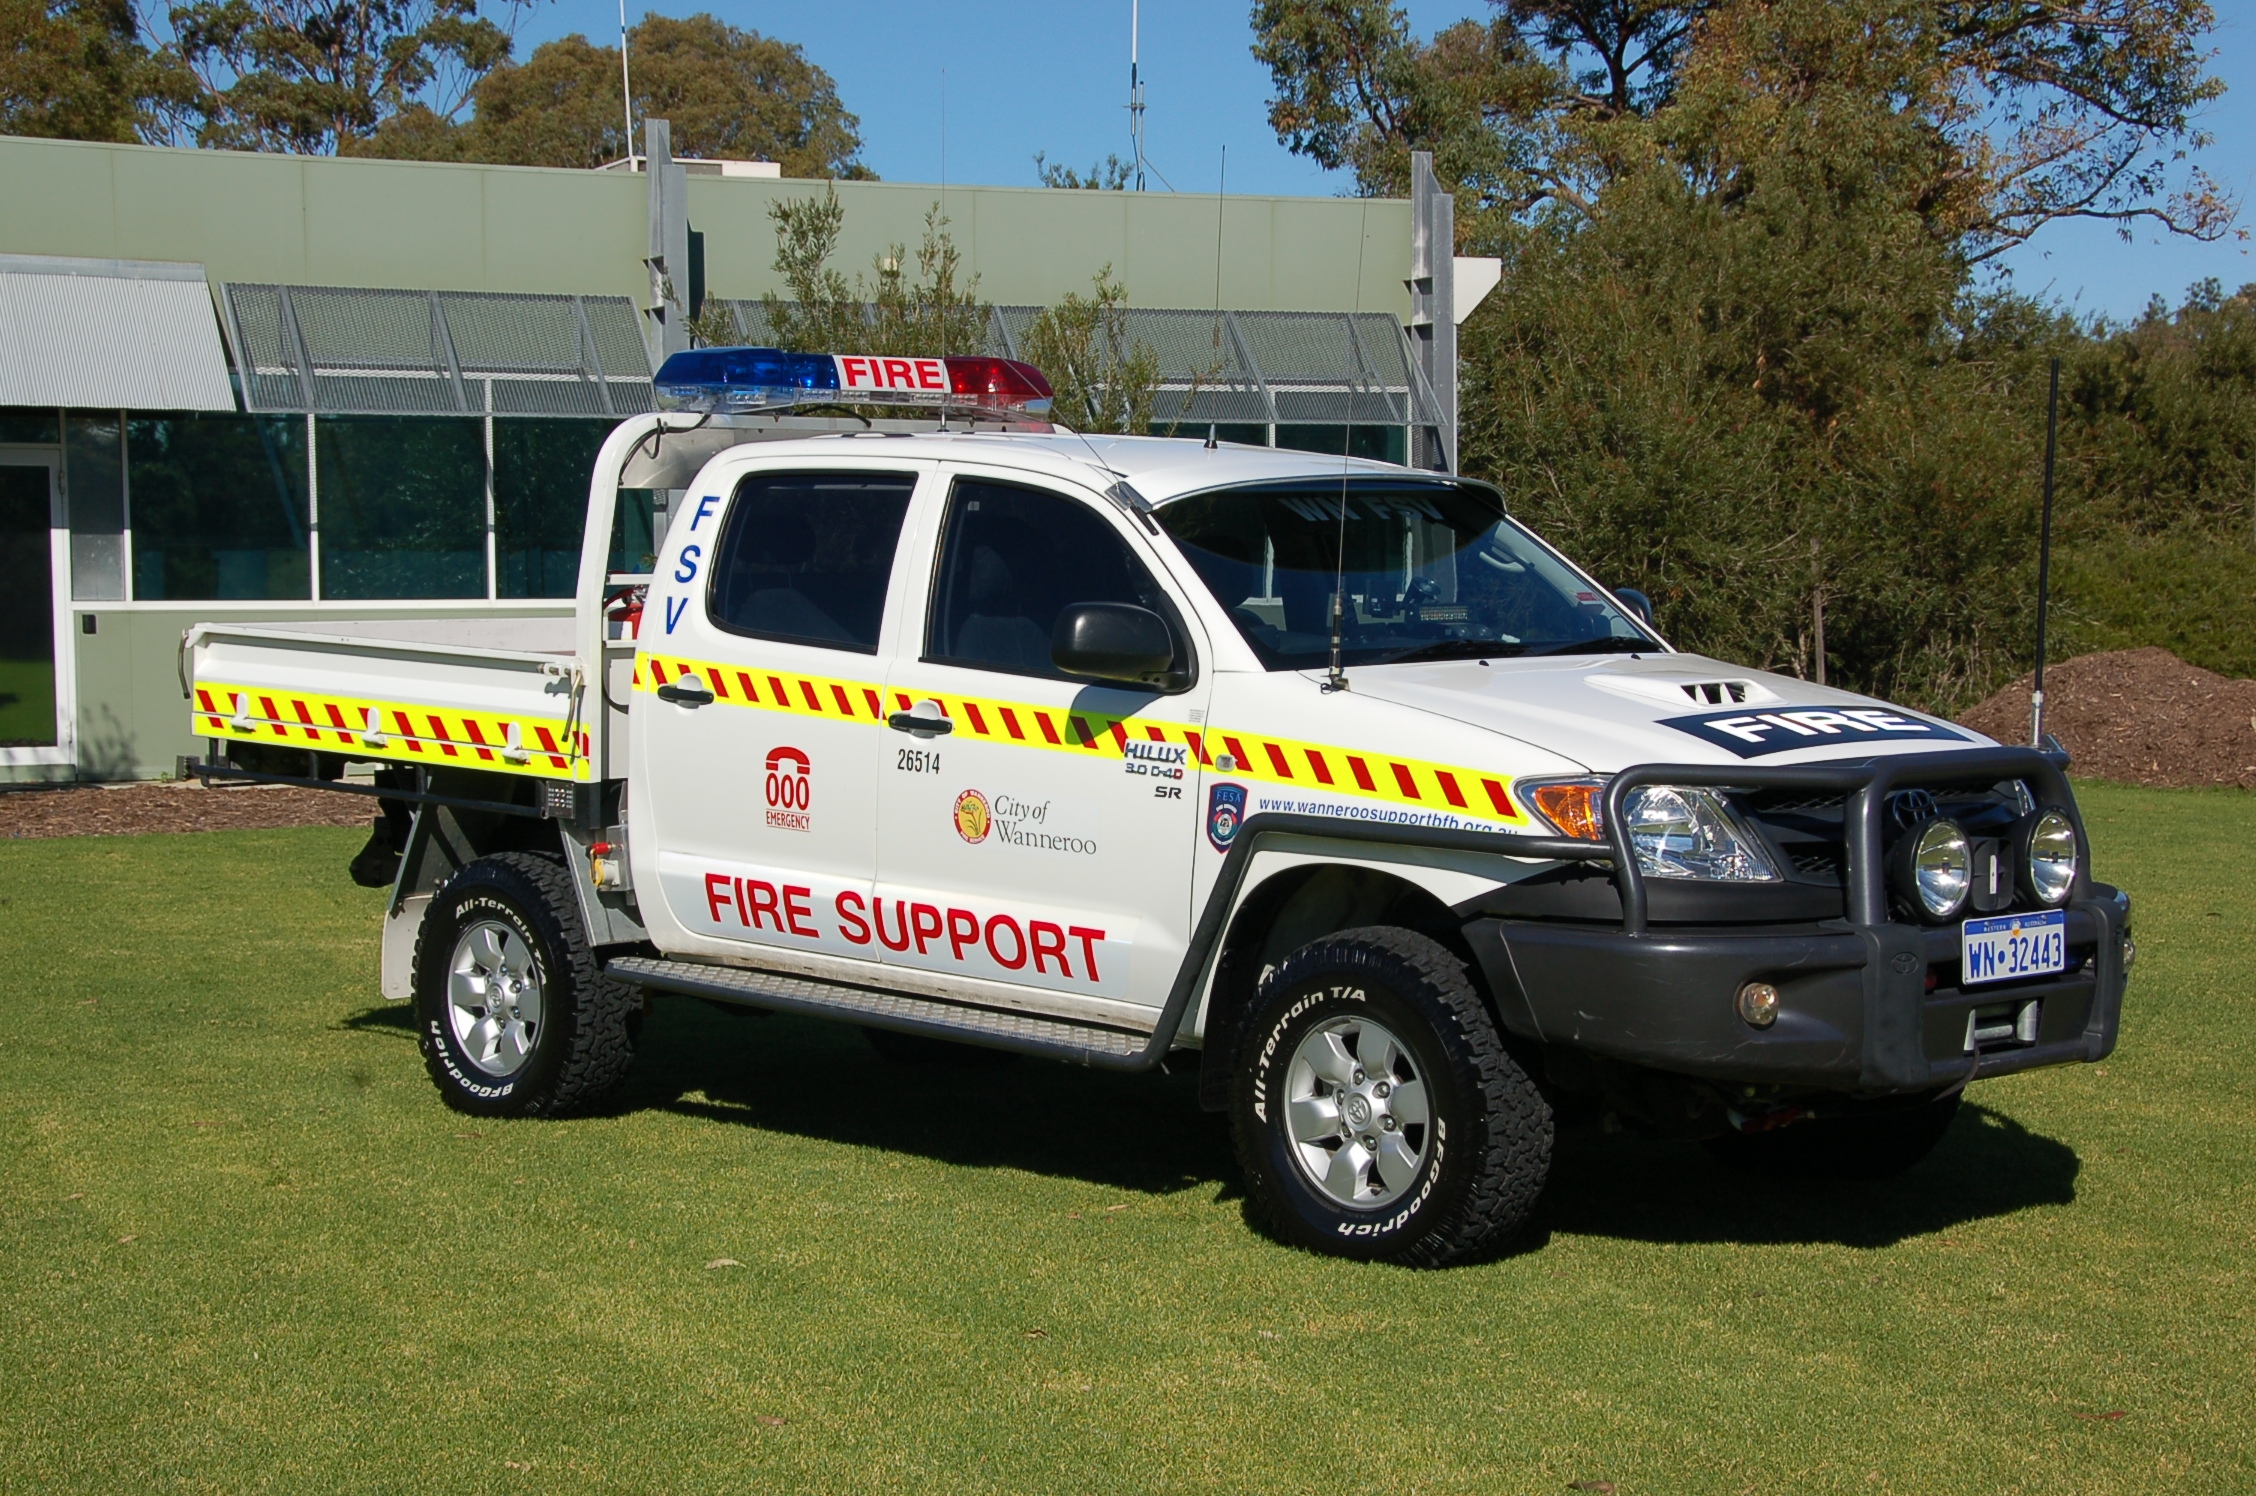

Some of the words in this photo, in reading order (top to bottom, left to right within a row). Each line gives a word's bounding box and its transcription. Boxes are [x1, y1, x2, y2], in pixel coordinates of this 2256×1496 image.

[840, 357, 944, 389] FIRE
[1703, 710, 1932, 743] FIRE
[897, 748, 940, 775] 26514
[1124, 742, 1186, 765] HILUX
[766, 772, 810, 810] 000
[1154, 786, 1182, 799] SR
[1216, 791, 1241, 803] FESA
[766, 811, 810, 830] EMERGENCY
[994, 795, 1030, 822] City
[1032, 800, 1051, 825] of
[994, 819, 1097, 855] Wanneroo
[454, 897, 535, 944] All-Terrain
[704, 873, 820, 939] FIRE
[834, 891, 1106, 983] SUPPORT
[430, 1020, 515, 1098] BFGoodrich
[1254, 992, 1325, 1123] All-Terrain
[1330, 986, 1366, 1002] T/A
[1337, 1116, 1447, 1238] BFGoodrich
